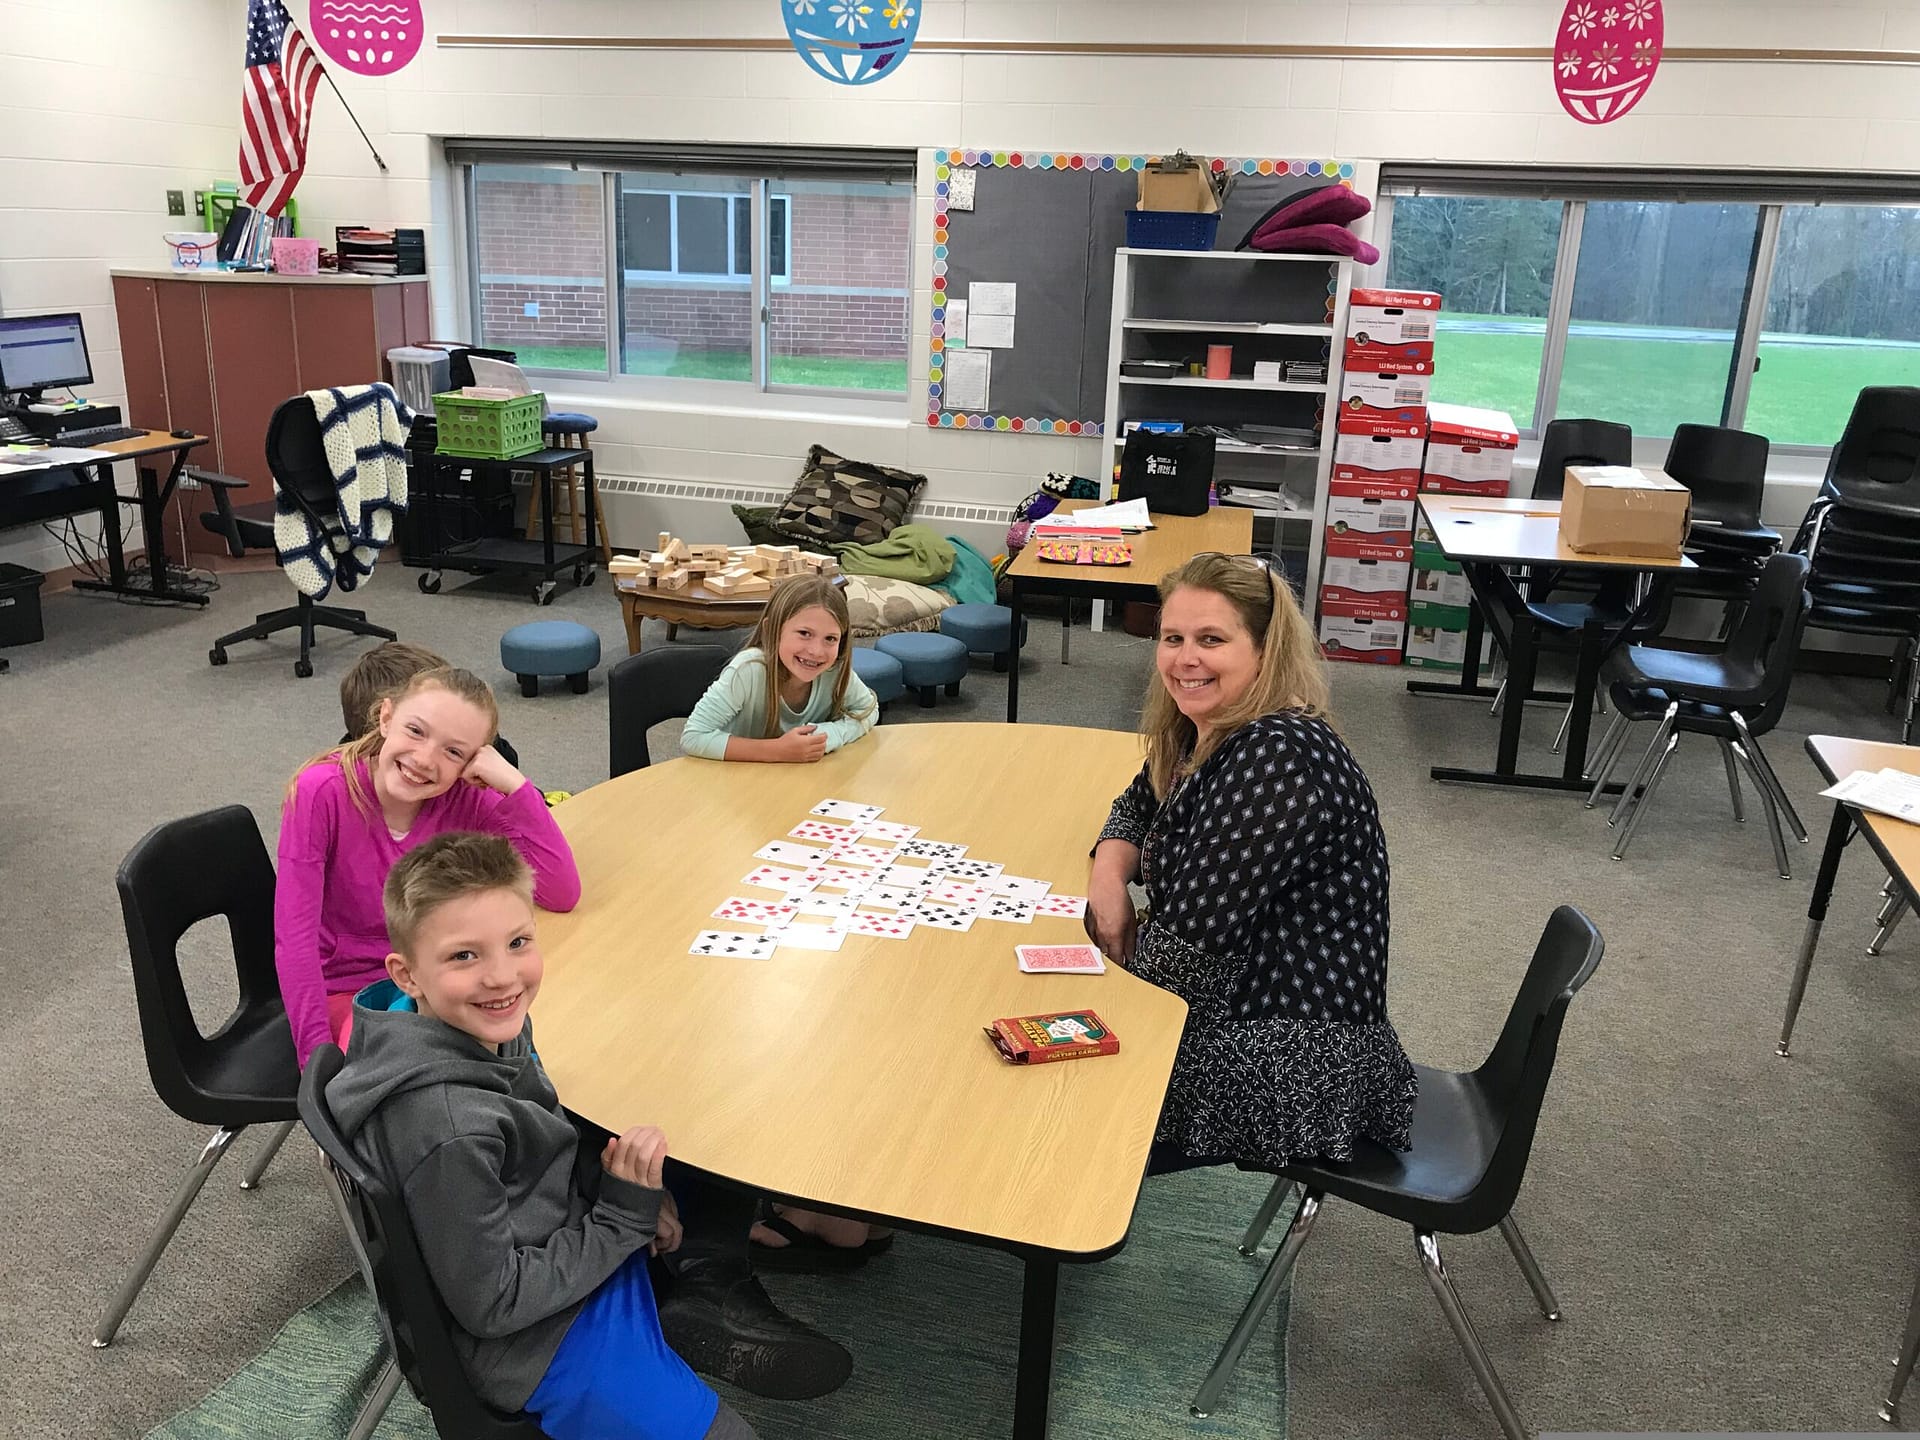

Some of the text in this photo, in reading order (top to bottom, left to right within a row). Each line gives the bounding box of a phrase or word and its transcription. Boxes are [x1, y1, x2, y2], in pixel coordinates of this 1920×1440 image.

[1402, 297, 1420, 305] System
[1390, 427, 1407, 435] System
[1380, 489, 1397, 497] System
[1018, 1018, 1045, 1048] PLAYING
[1029, 1020, 1051, 1043] CARDS
[1047, 1048, 1101, 1060] PLAYING CARDS
